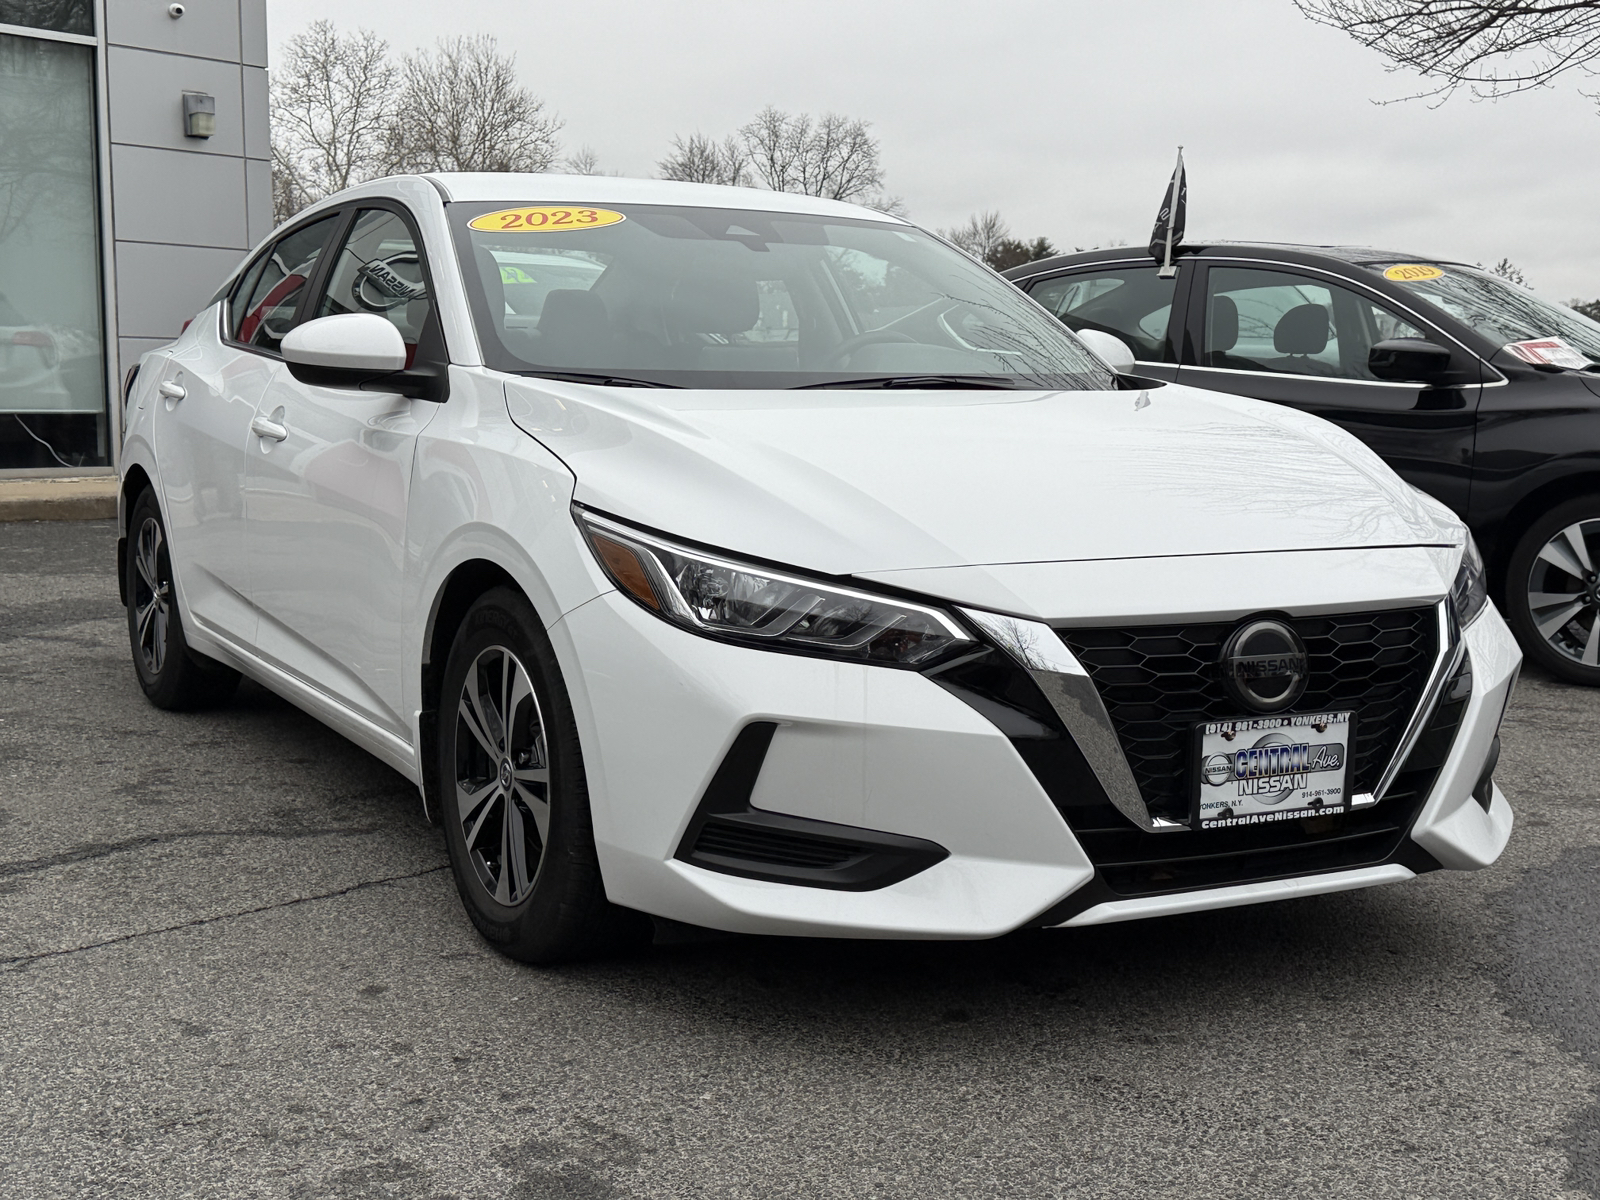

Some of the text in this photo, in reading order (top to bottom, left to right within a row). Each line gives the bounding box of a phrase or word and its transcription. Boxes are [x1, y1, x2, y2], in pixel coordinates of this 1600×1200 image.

[500, 210, 599, 229] 2023
[1394, 266, 1436, 280] 2019
[1237, 657, 1300, 675] NISSAN
[1204, 765, 1233, 774] NISSAN
[1234, 743, 1340, 780] CENTRAL Ave.
[1238, 773, 1307, 797] NISSAN
[1302, 787, 1341, 798] 914-961-3900
